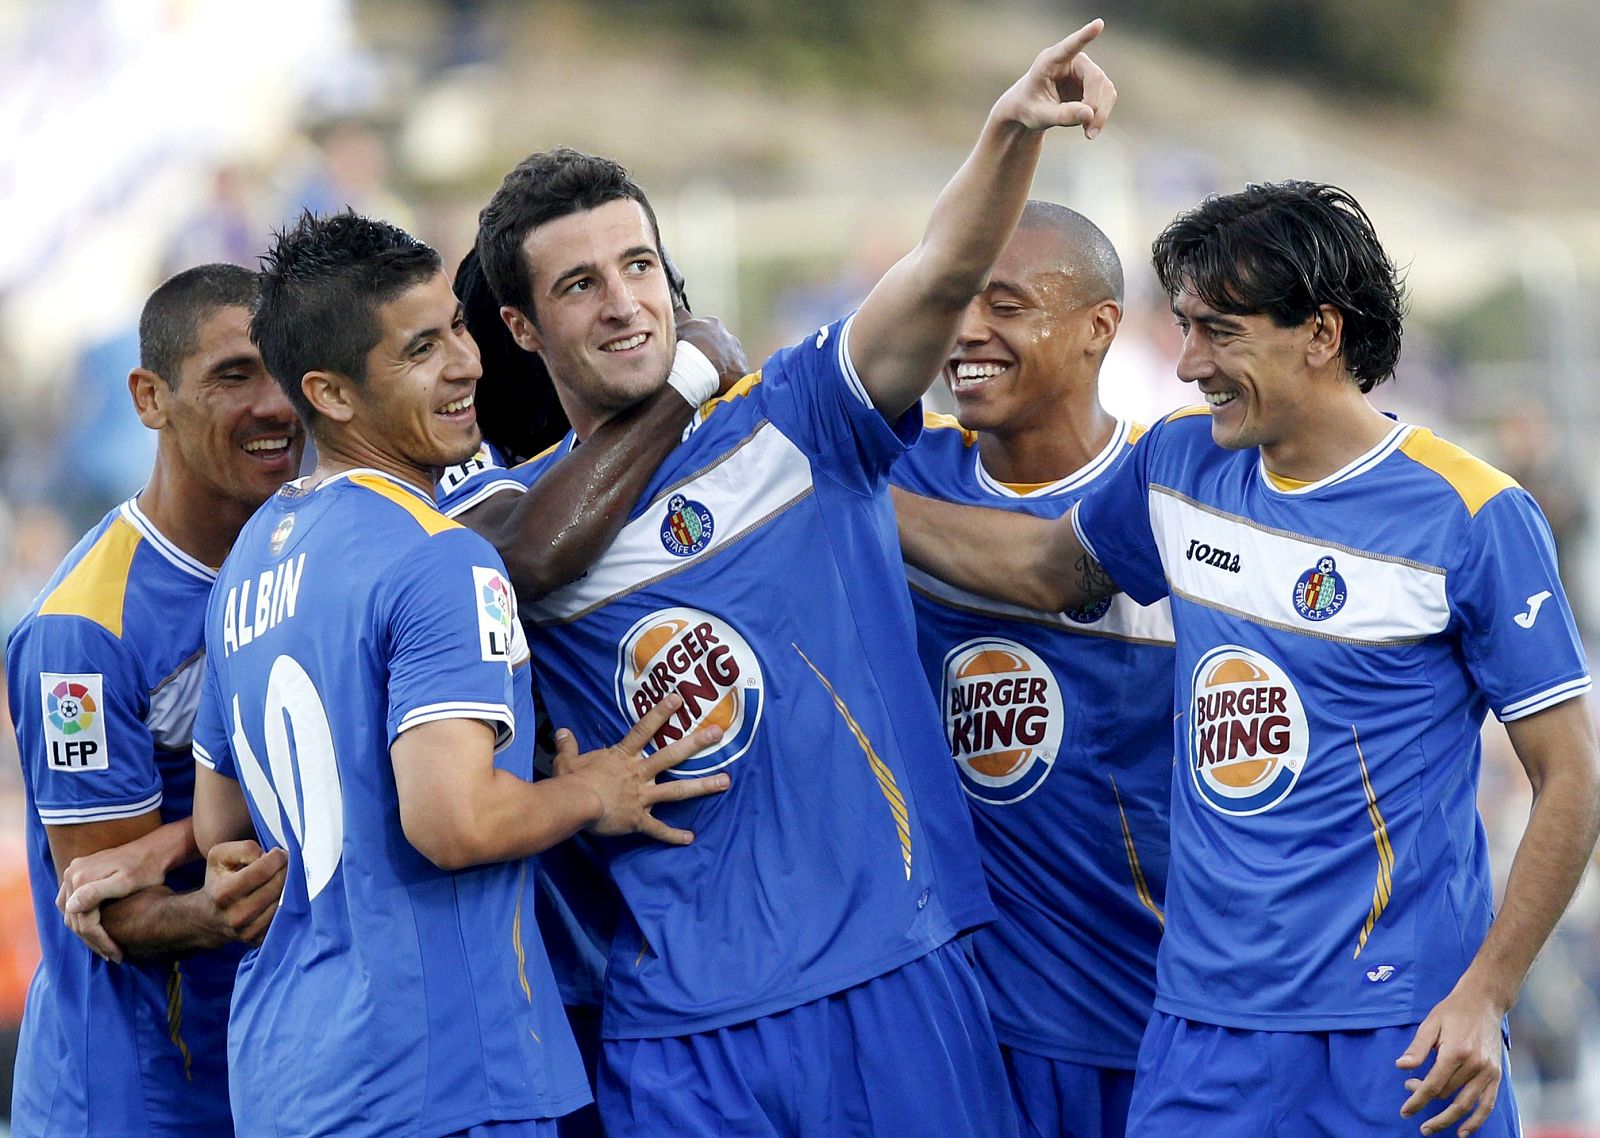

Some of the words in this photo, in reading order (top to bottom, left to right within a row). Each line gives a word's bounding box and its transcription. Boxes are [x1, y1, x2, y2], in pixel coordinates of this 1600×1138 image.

[662, 530, 689, 554] GETAFE
[223, 552, 306, 658] ALBIN
[1295, 582, 1309, 614] GETAFE
[1325, 591, 1345, 615] S.A.D.
[632, 621, 720, 720] BURGER
[951, 677, 1048, 717] BURGER
[1197, 686, 1287, 727] BURGER
[52, 740, 98, 767] LFP
[951, 705, 1050, 758] KING
[1197, 715, 1291, 769] KING
[232, 654, 343, 904] 10
